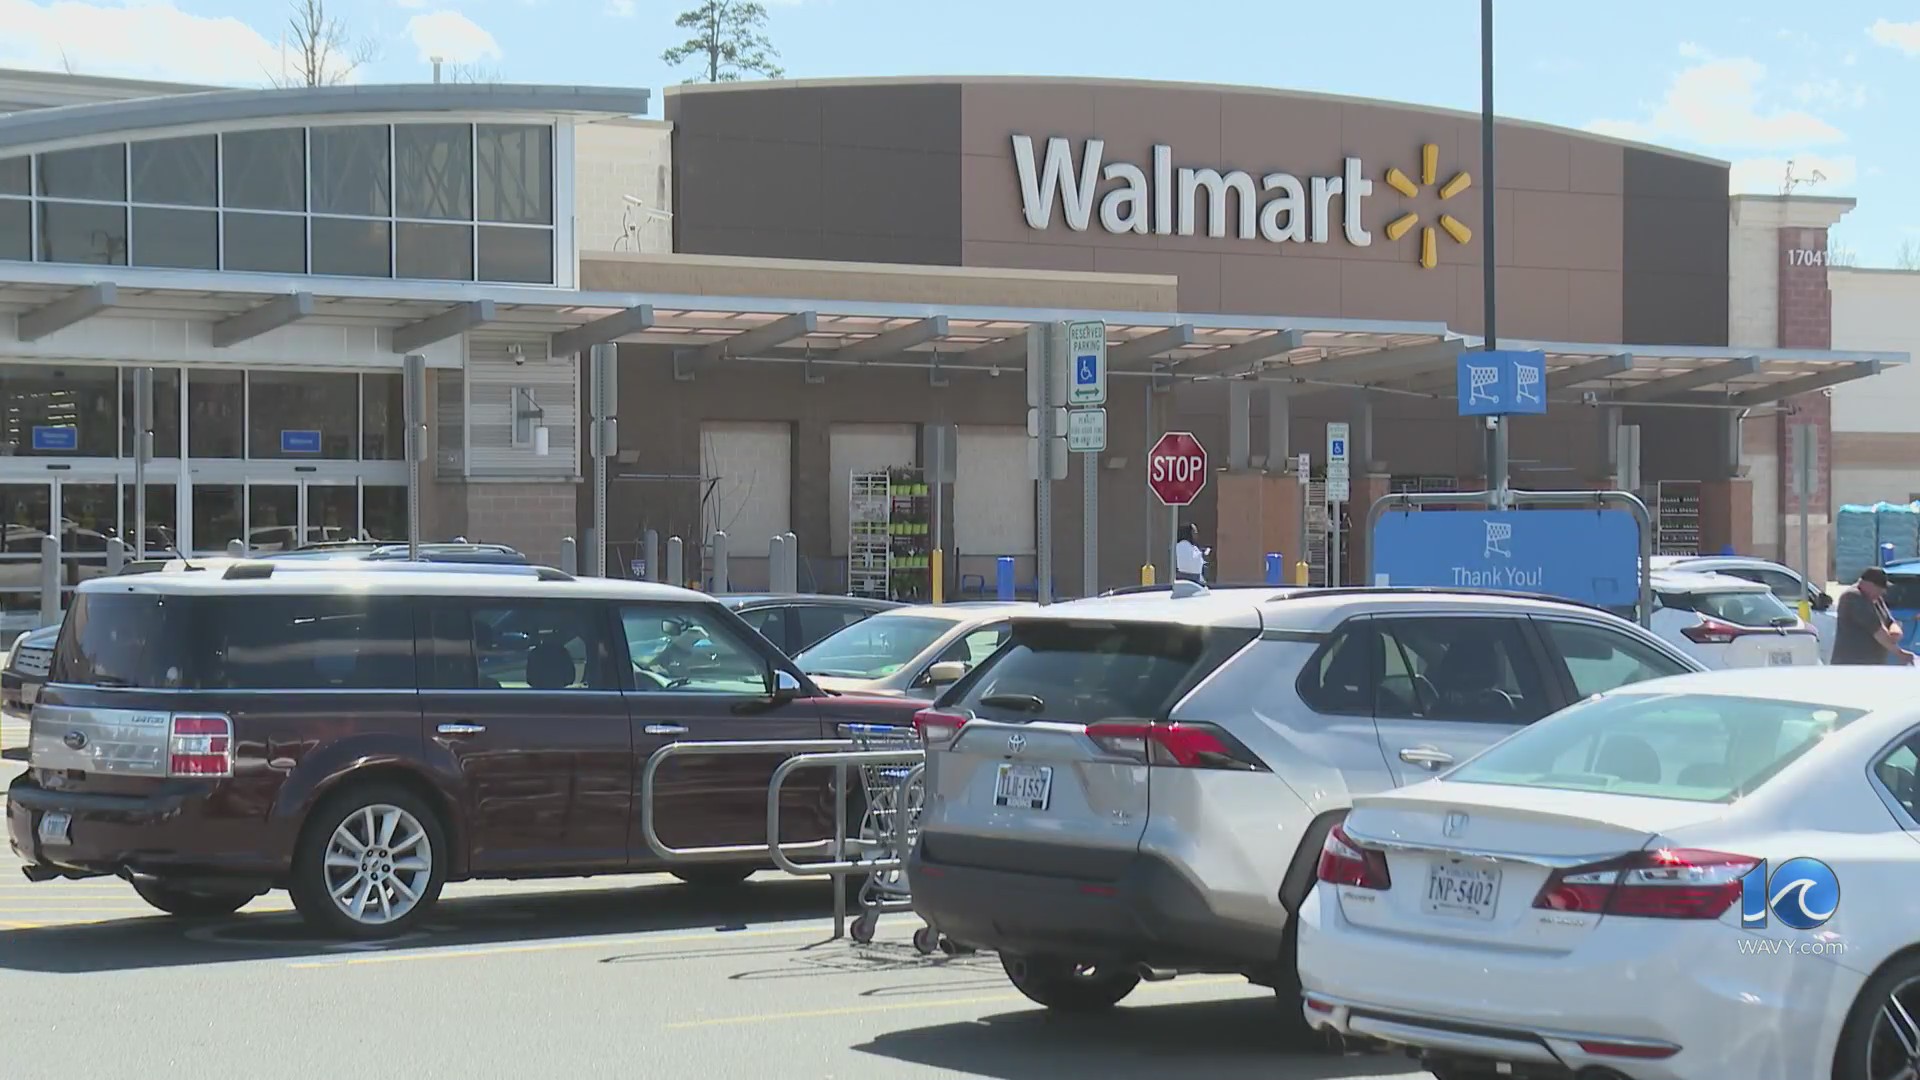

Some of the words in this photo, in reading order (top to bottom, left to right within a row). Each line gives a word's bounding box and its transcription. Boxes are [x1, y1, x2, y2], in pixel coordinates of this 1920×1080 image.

[1011, 134, 1373, 247] Walmart
[1071, 327, 1102, 340] RESERVED
[1073, 340, 1100, 352] PARKING
[1152, 455, 1203, 482] STOP
[1452, 566, 1501, 586] Thank
[1505, 566, 1542, 586] You!
[1428, 876, 1493, 906] TNP-5402
